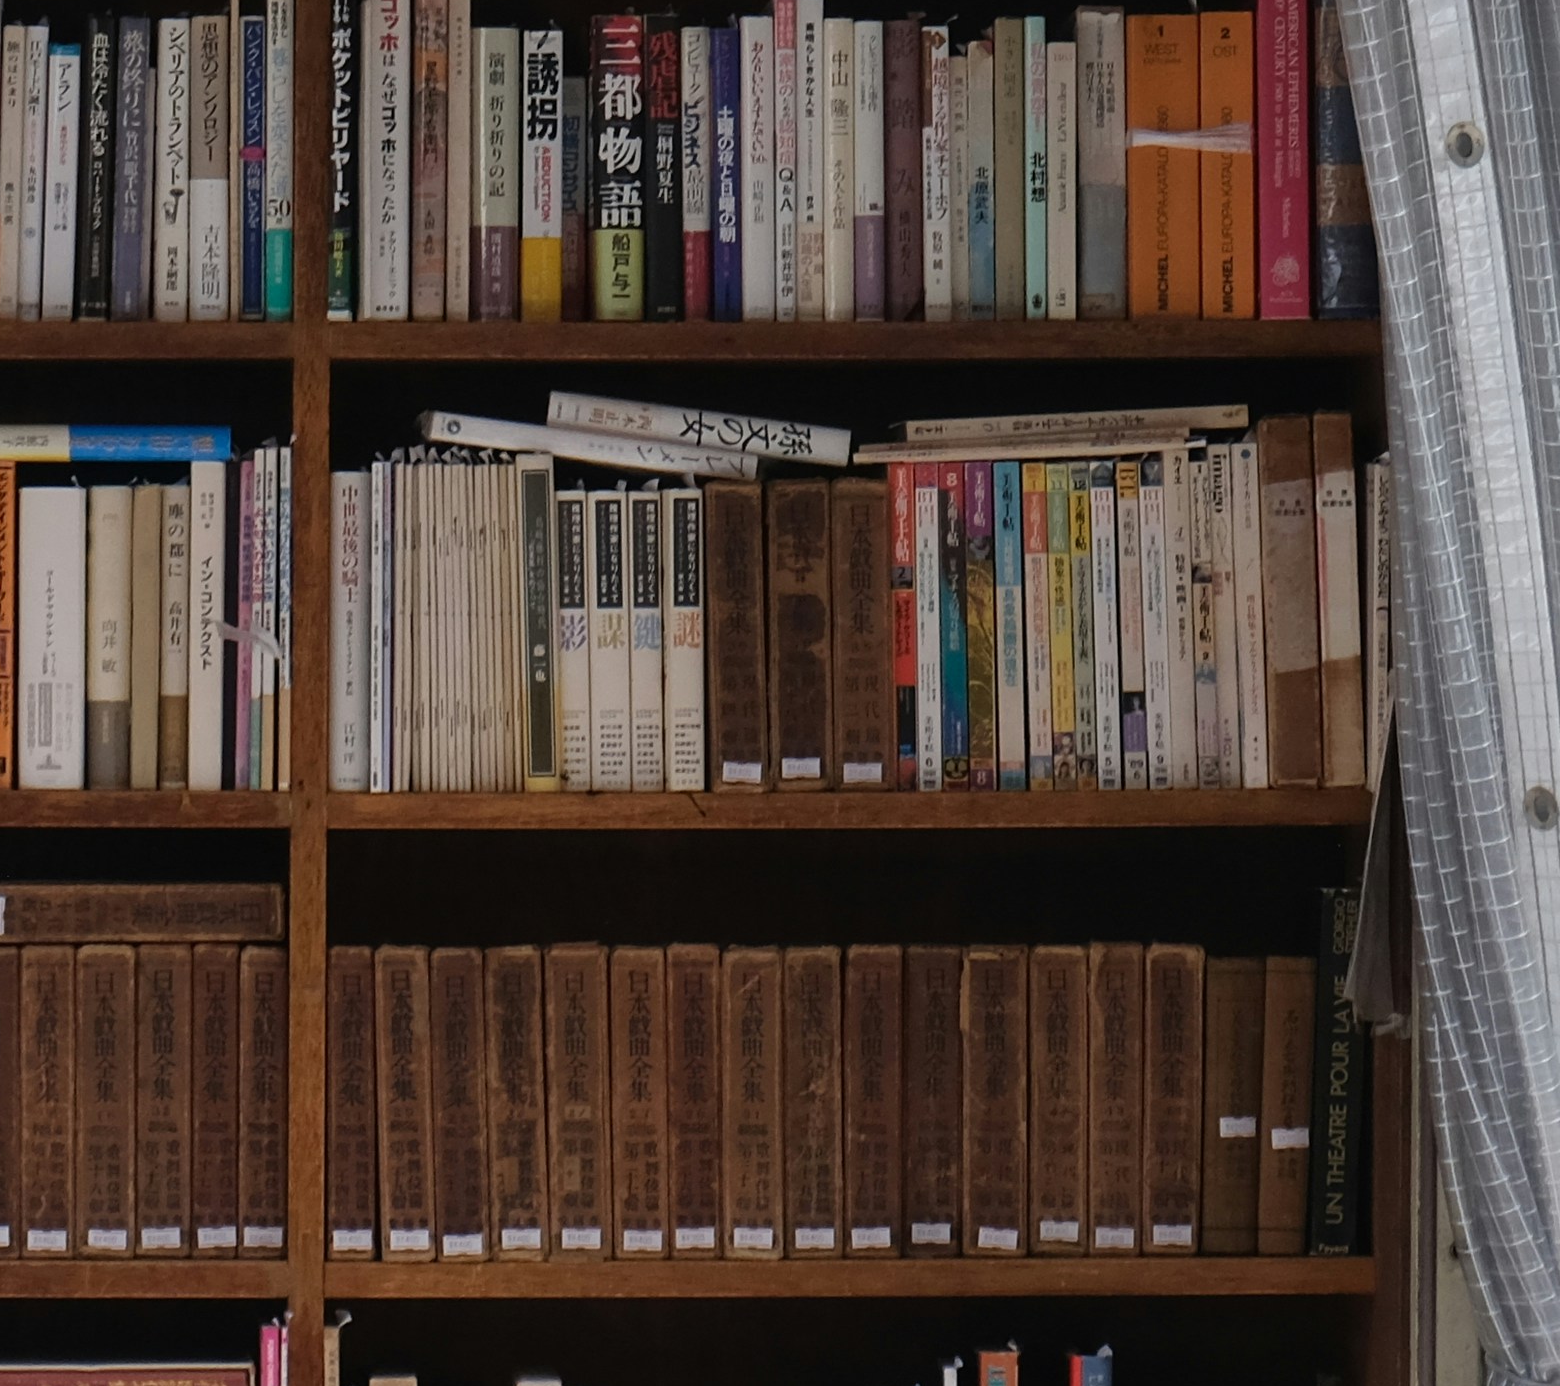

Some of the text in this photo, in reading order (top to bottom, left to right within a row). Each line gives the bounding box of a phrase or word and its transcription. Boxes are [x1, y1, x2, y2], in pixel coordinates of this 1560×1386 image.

[1143, 43, 1180, 56] WEST
[1212, 45, 1238, 58] OST
[1219, 27, 1231, 39] 2
[57, 61, 73, 113] アラン
[90, 31, 111, 158] 血は冷たく流れる
[122, 28, 144, 127] 旅の終りに
[167, 26, 188, 186] シベリアのトランペット
[200, 22, 219, 163] 思想のアンソロジー
[526, 51, 560, 142] 誘拐
[648, 29, 679, 120] 残虐記
[1286, 69, 1299, 149] EPHEMERIS
[330, 28, 352, 213] ポケットビリヤード
[598, 13, 643, 229] 三都物語
[539, 145, 553, 223] ABDUCTION
[656, 135, 675, 206] 桐野夏生
[715, 105, 738, 244] 土曜の夜と日曜の朝
[1029, 151, 1047, 203] 北村想
[200, 224, 221, 301] 吉本隆明
[610, 232, 632, 301] 船戸与一
[1157, 150, 1170, 312] MICHEL EUROPA-KATALO
[1222, 256, 1233, 313] MICHEL
[681, 412, 813, 457] 孫文の女
[895, 472, 909, 563] 美術手帖
[948, 490, 959, 548] 美術手帖
[974, 467, 985, 527] 美術手帖
[1002, 471, 1014, 532] 美術手帖
[1074, 496, 1087, 552] 美術手帖
[342, 484, 359, 604] 中世最後の騎士
[200, 555, 213, 671] イン・コンテクスト
[1334, 1010, 1351, 1034] LA
[1329, 1041, 1348, 1101] POUR
[1327, 1110, 1347, 1185] THEATRE
[1326, 1193, 1344, 1224] UN
